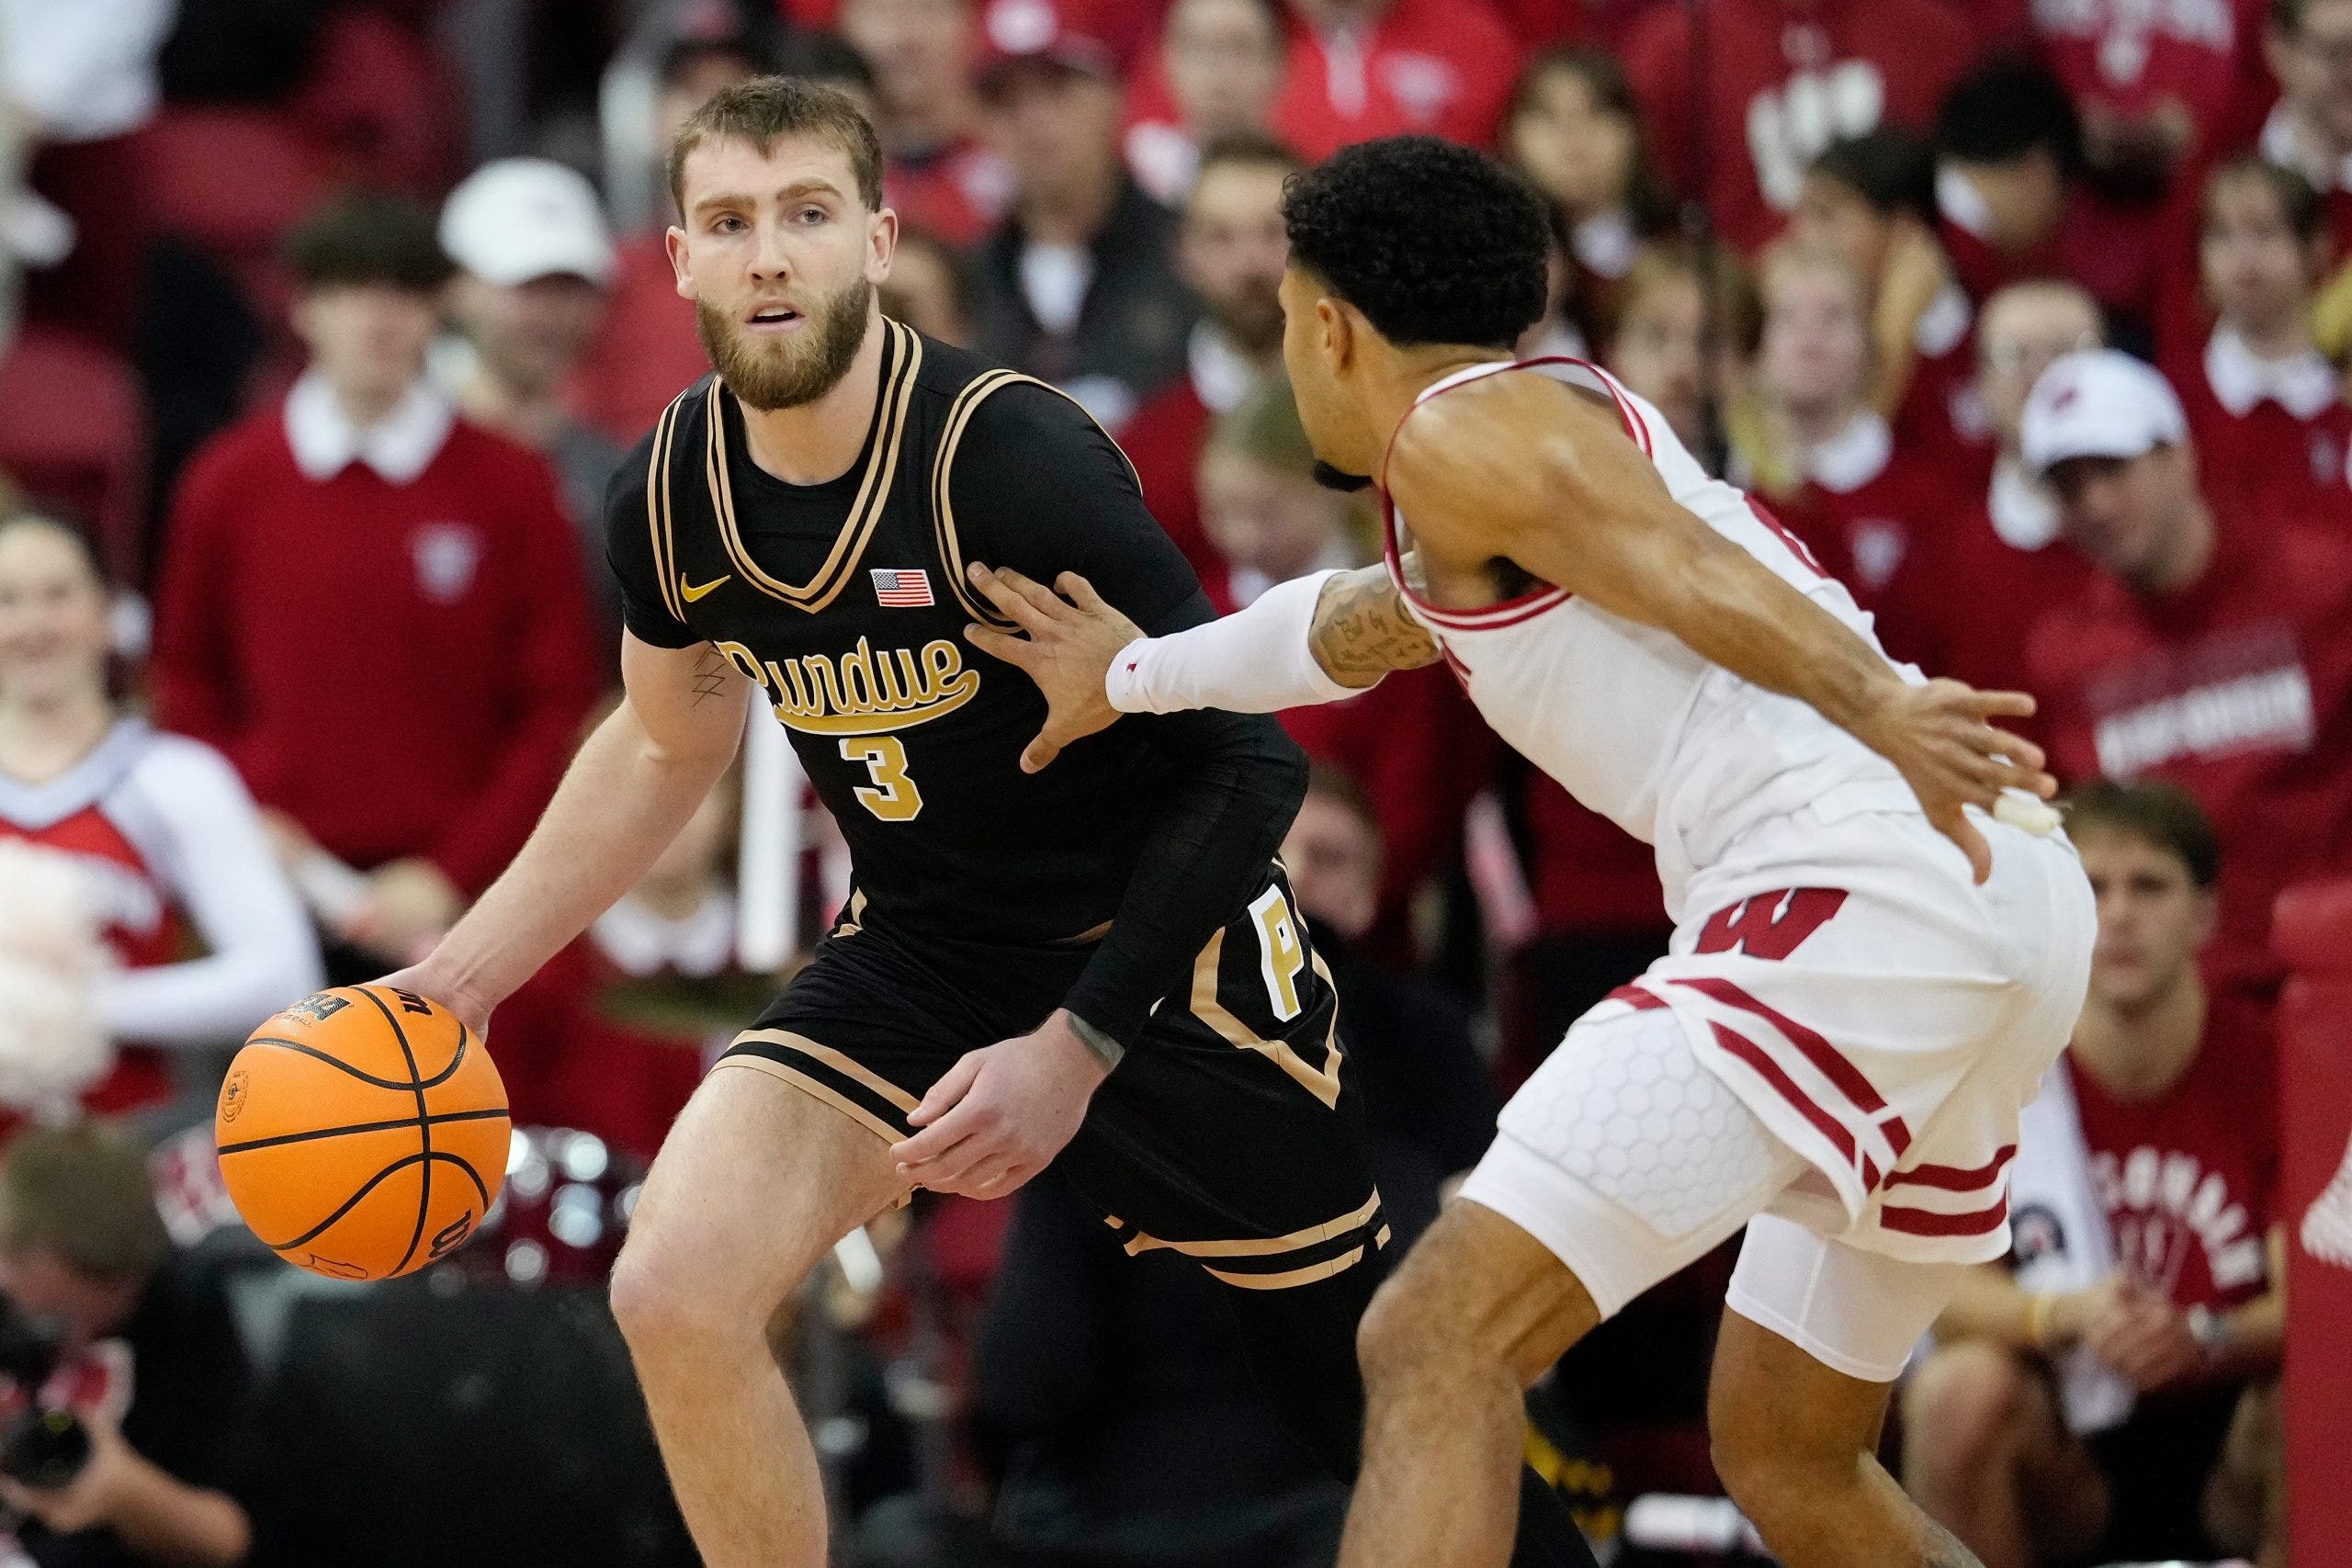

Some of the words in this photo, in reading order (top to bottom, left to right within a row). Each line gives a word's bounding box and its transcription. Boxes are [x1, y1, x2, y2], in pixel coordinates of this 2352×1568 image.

[713, 636, 980, 735] Purdue
[839, 736, 923, 821] 3
[1248, 884, 1305, 1022] P
[1693, 886, 1849, 962] W
